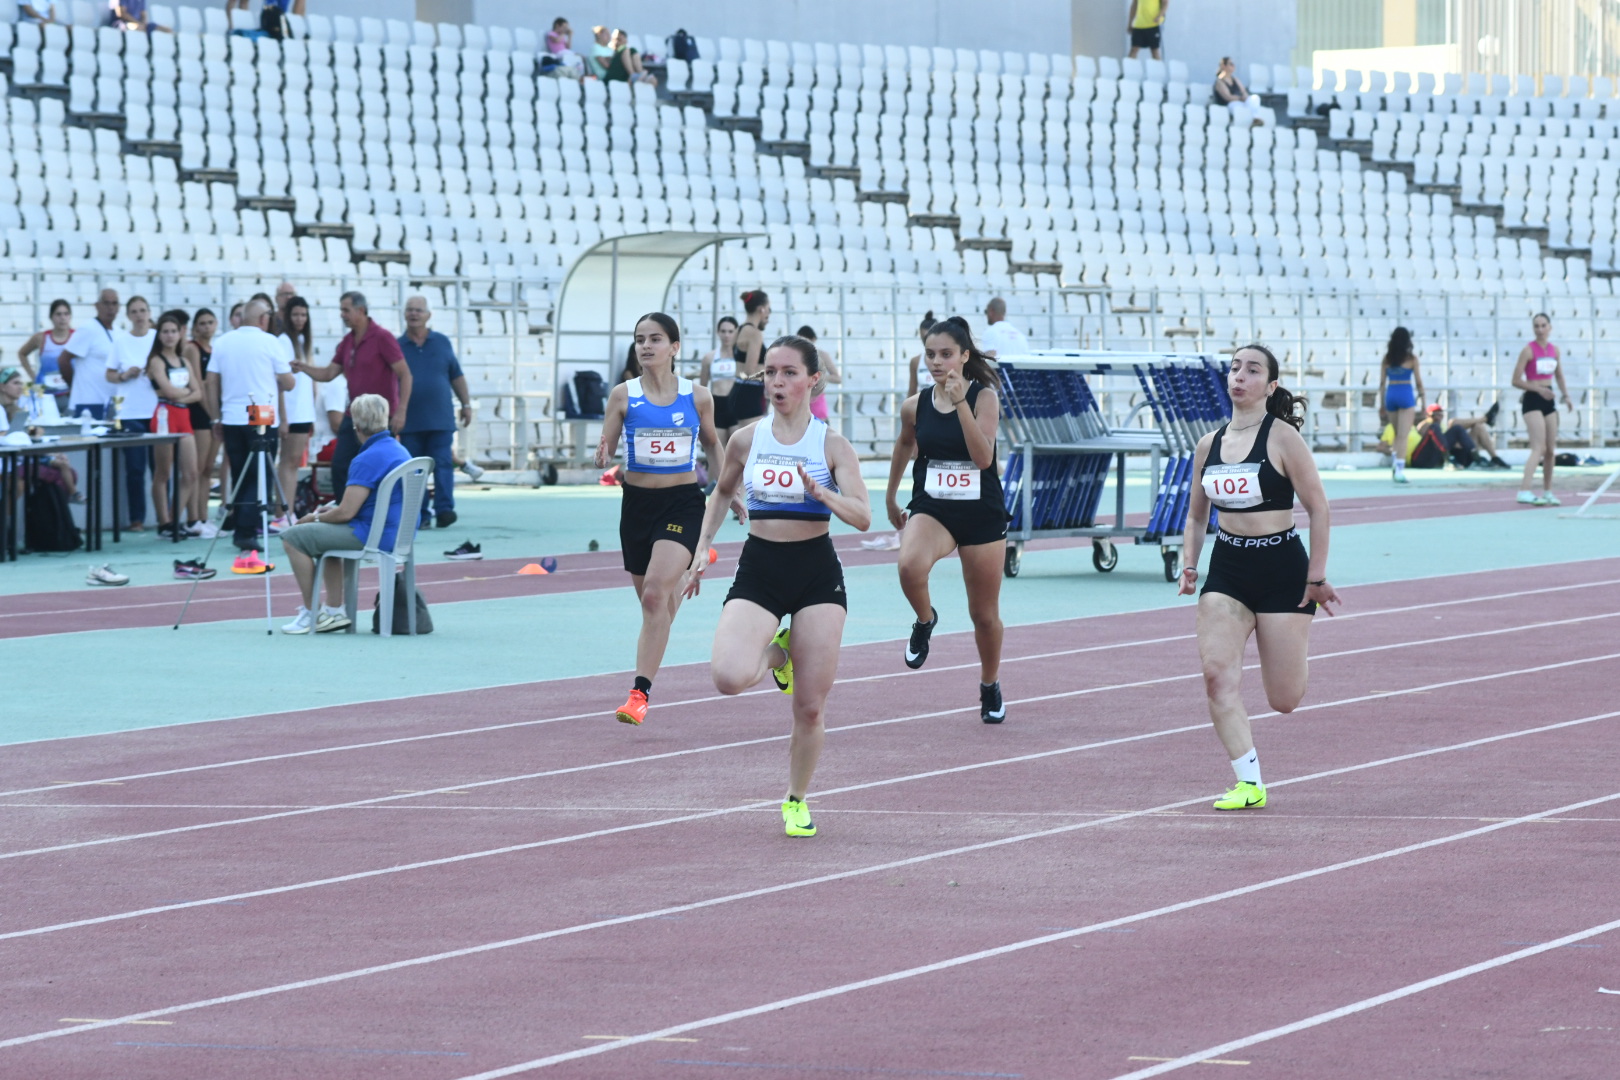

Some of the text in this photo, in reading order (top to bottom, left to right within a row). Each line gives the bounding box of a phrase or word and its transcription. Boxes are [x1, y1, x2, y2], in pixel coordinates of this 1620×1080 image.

[650, 440, 676, 454] 54
[762, 469, 793, 488] 90
[937, 472, 971, 488] 105
[1212, 477, 1249, 495] 102
[1218, 528, 1243, 547] NIKE
[1244, 535, 1282, 548] PRO
